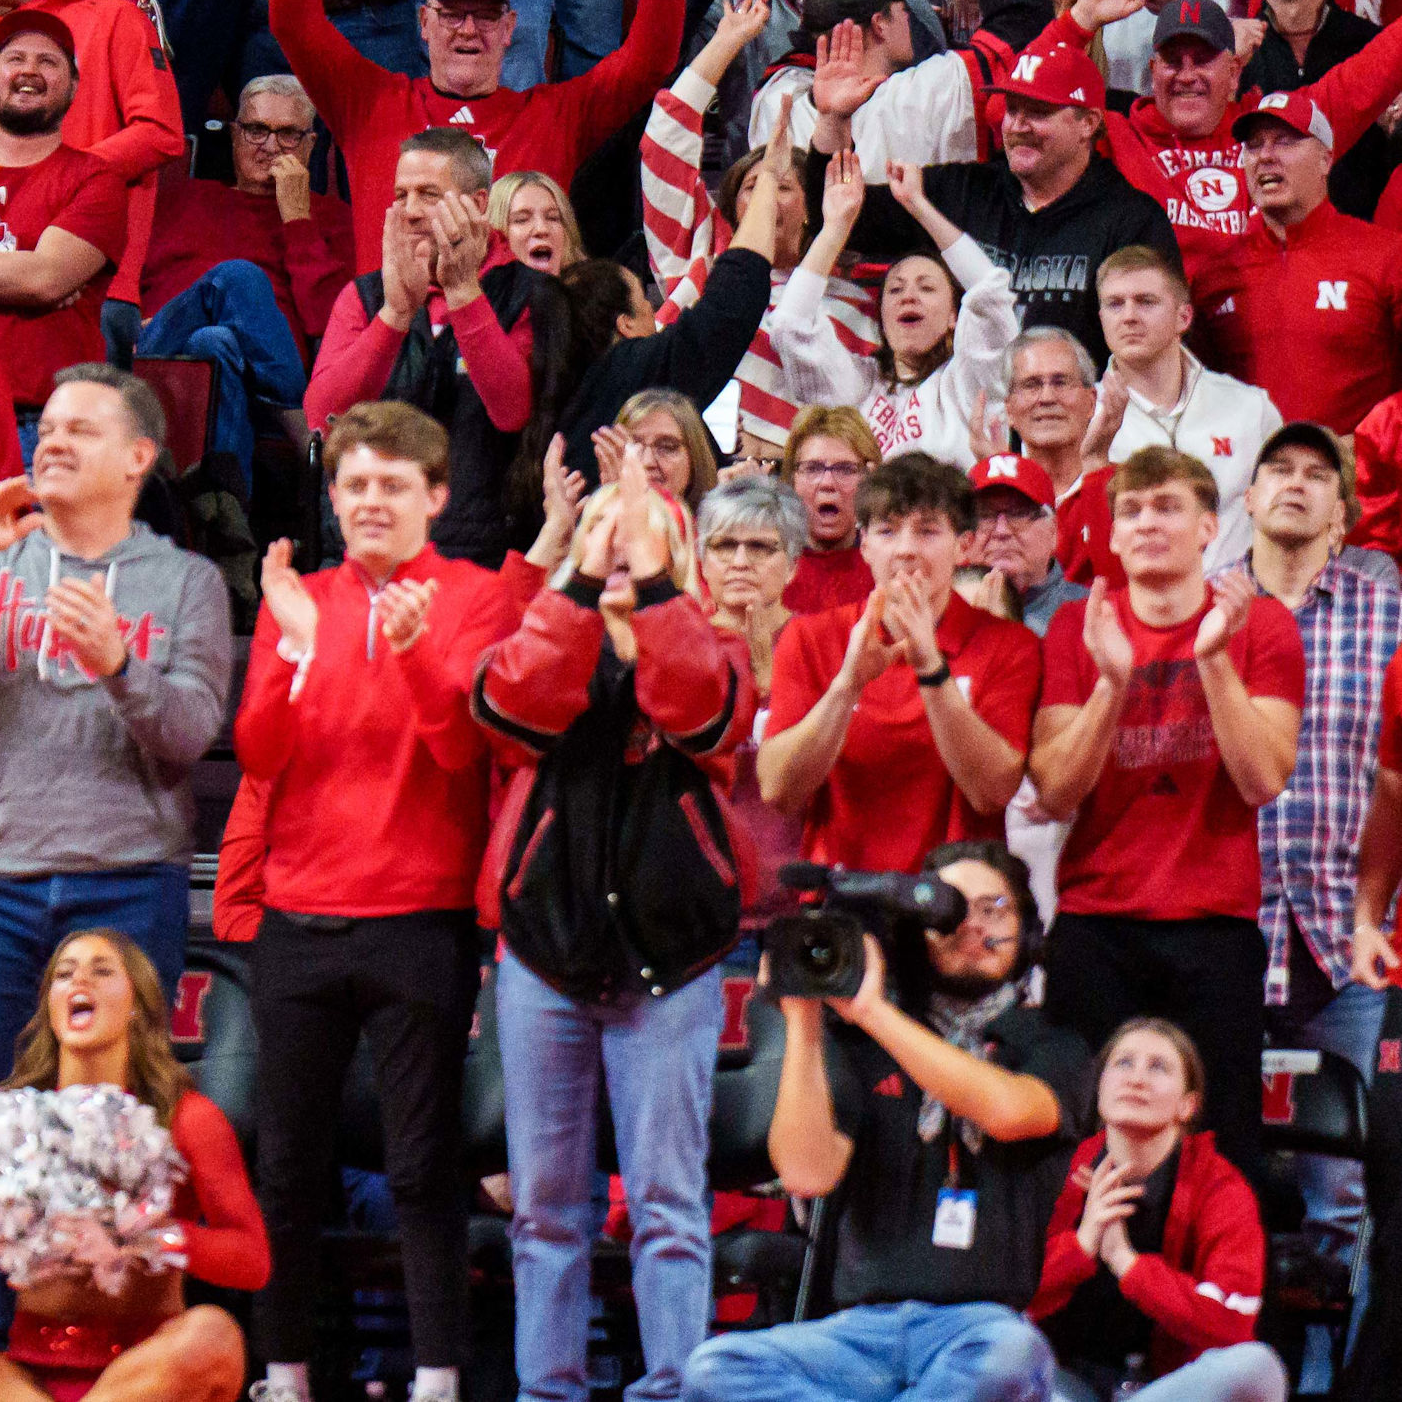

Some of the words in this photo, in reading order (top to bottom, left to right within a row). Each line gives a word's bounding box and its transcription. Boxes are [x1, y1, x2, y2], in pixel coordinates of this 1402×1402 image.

[1179, 0, 1201, 25] N
[1010, 54, 1043, 83] N
[1198, 179, 1224, 200] N
[1314, 280, 1348, 311] N
[1210, 436, 1232, 457] N
[985, 454, 1019, 478] N
